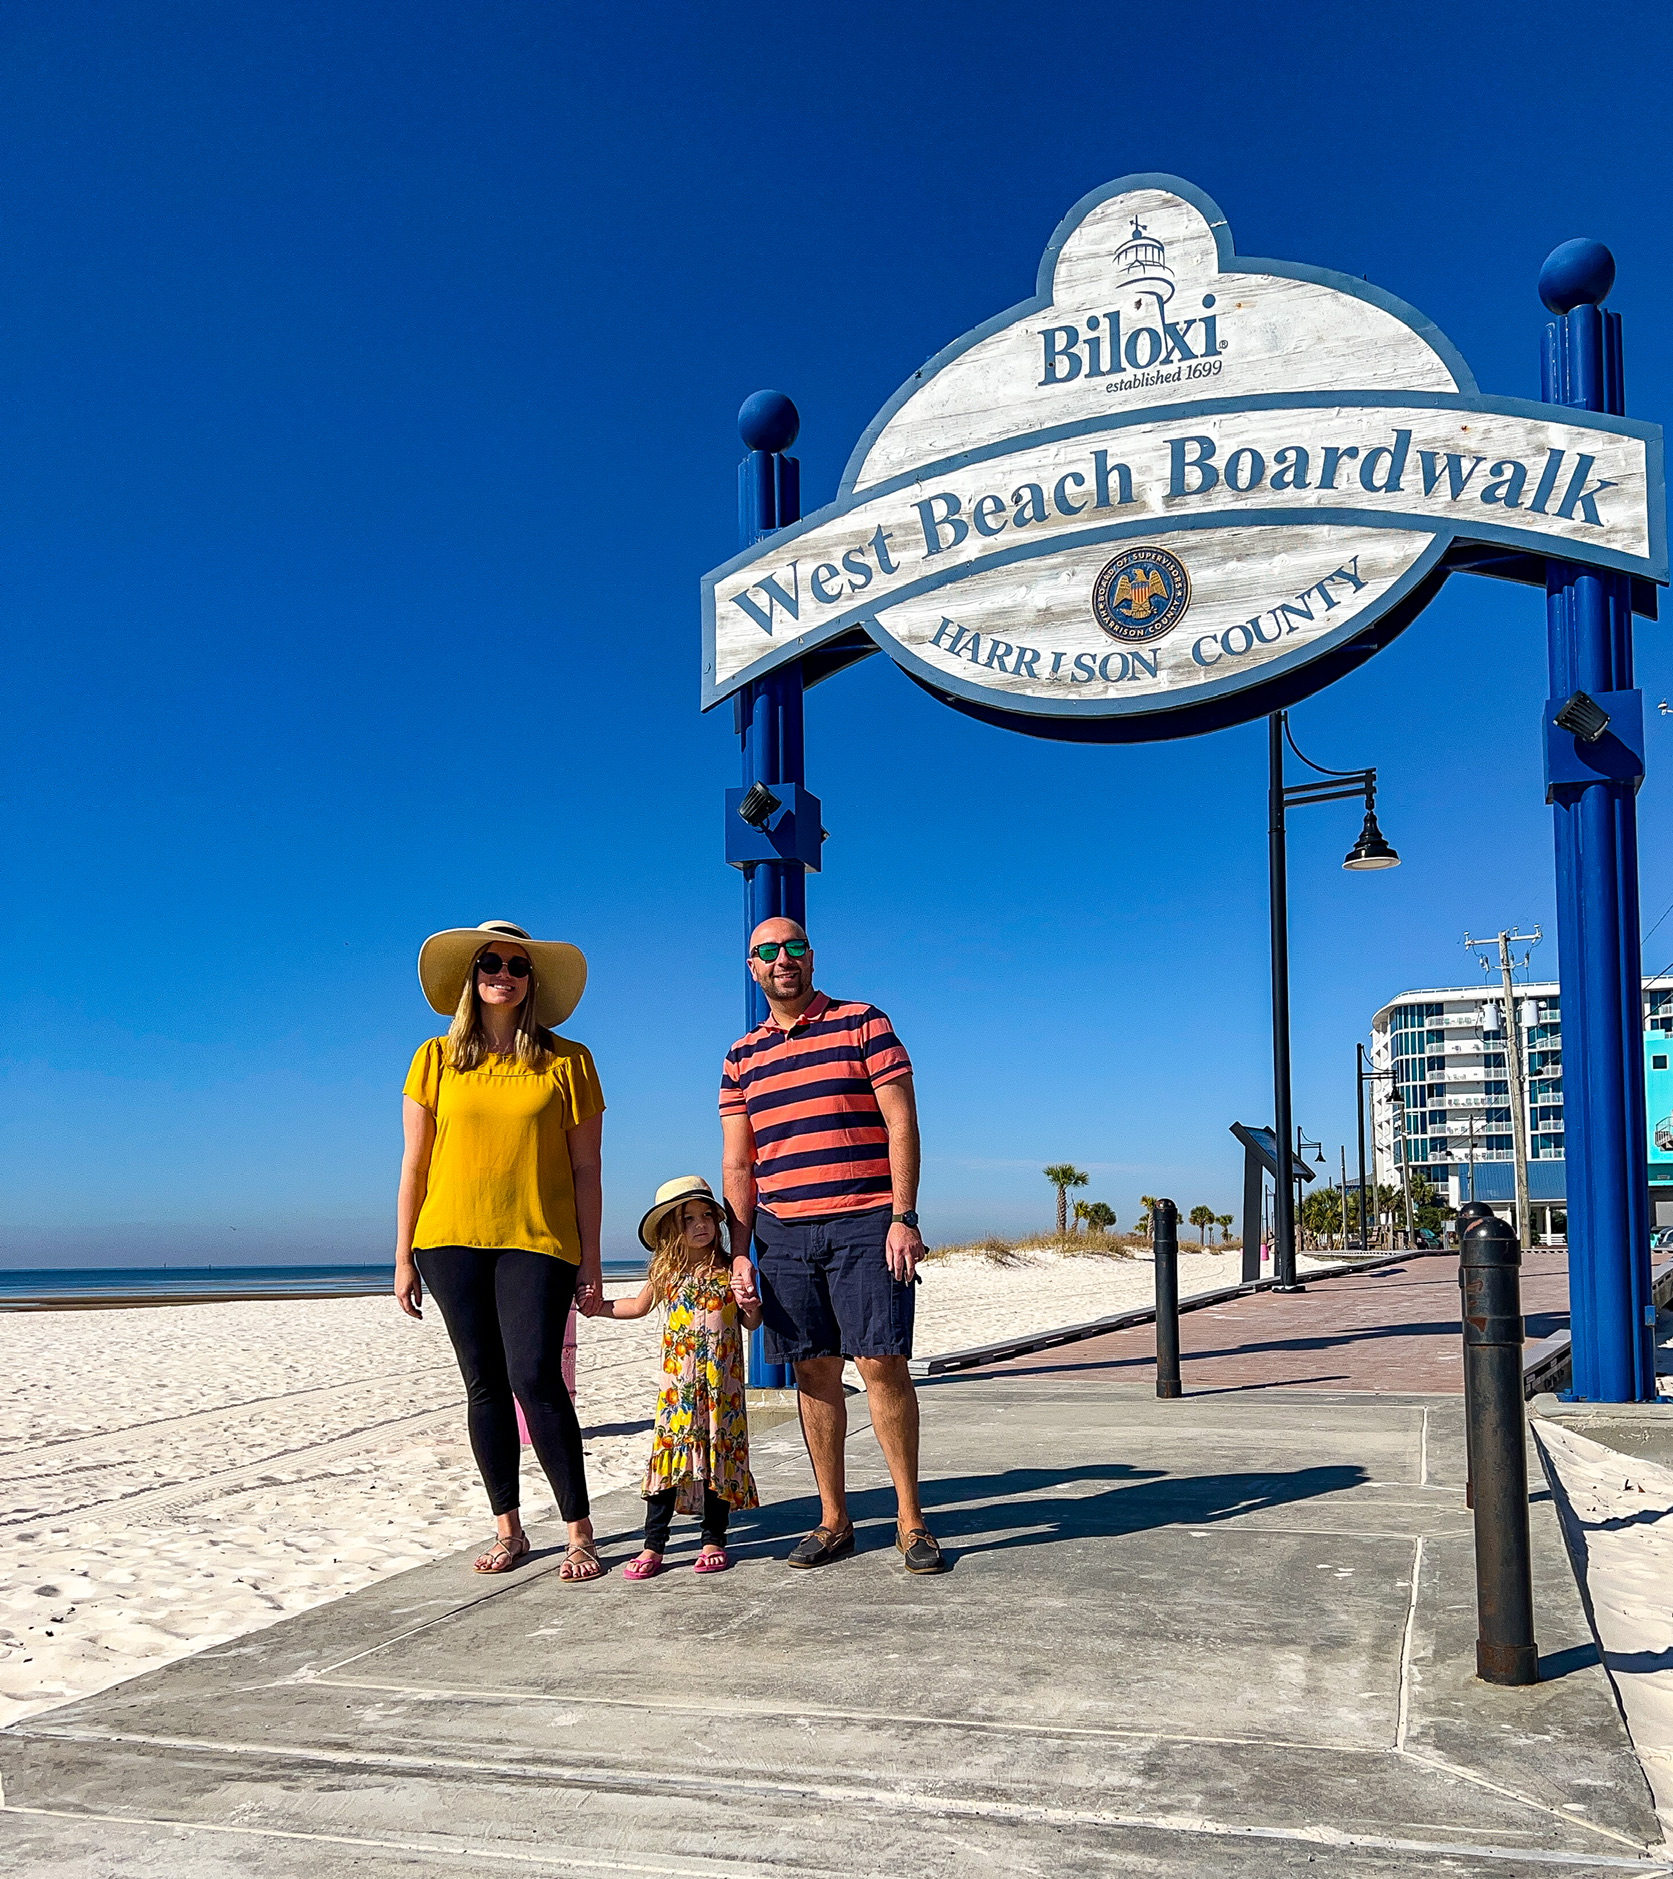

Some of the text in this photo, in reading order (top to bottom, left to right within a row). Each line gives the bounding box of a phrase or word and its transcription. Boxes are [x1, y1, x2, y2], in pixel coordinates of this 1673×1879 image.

[1105, 359, 1223, 393] established 1699
[729, 428, 1619, 637] West Beach Boardwalk
[1098, 551, 1183, 602] BOARD OF SUPERVISORS
[928, 555, 1369, 684] HARRISON COUNTY
[1100, 599, 1181, 637] HARRISON COUNTY
